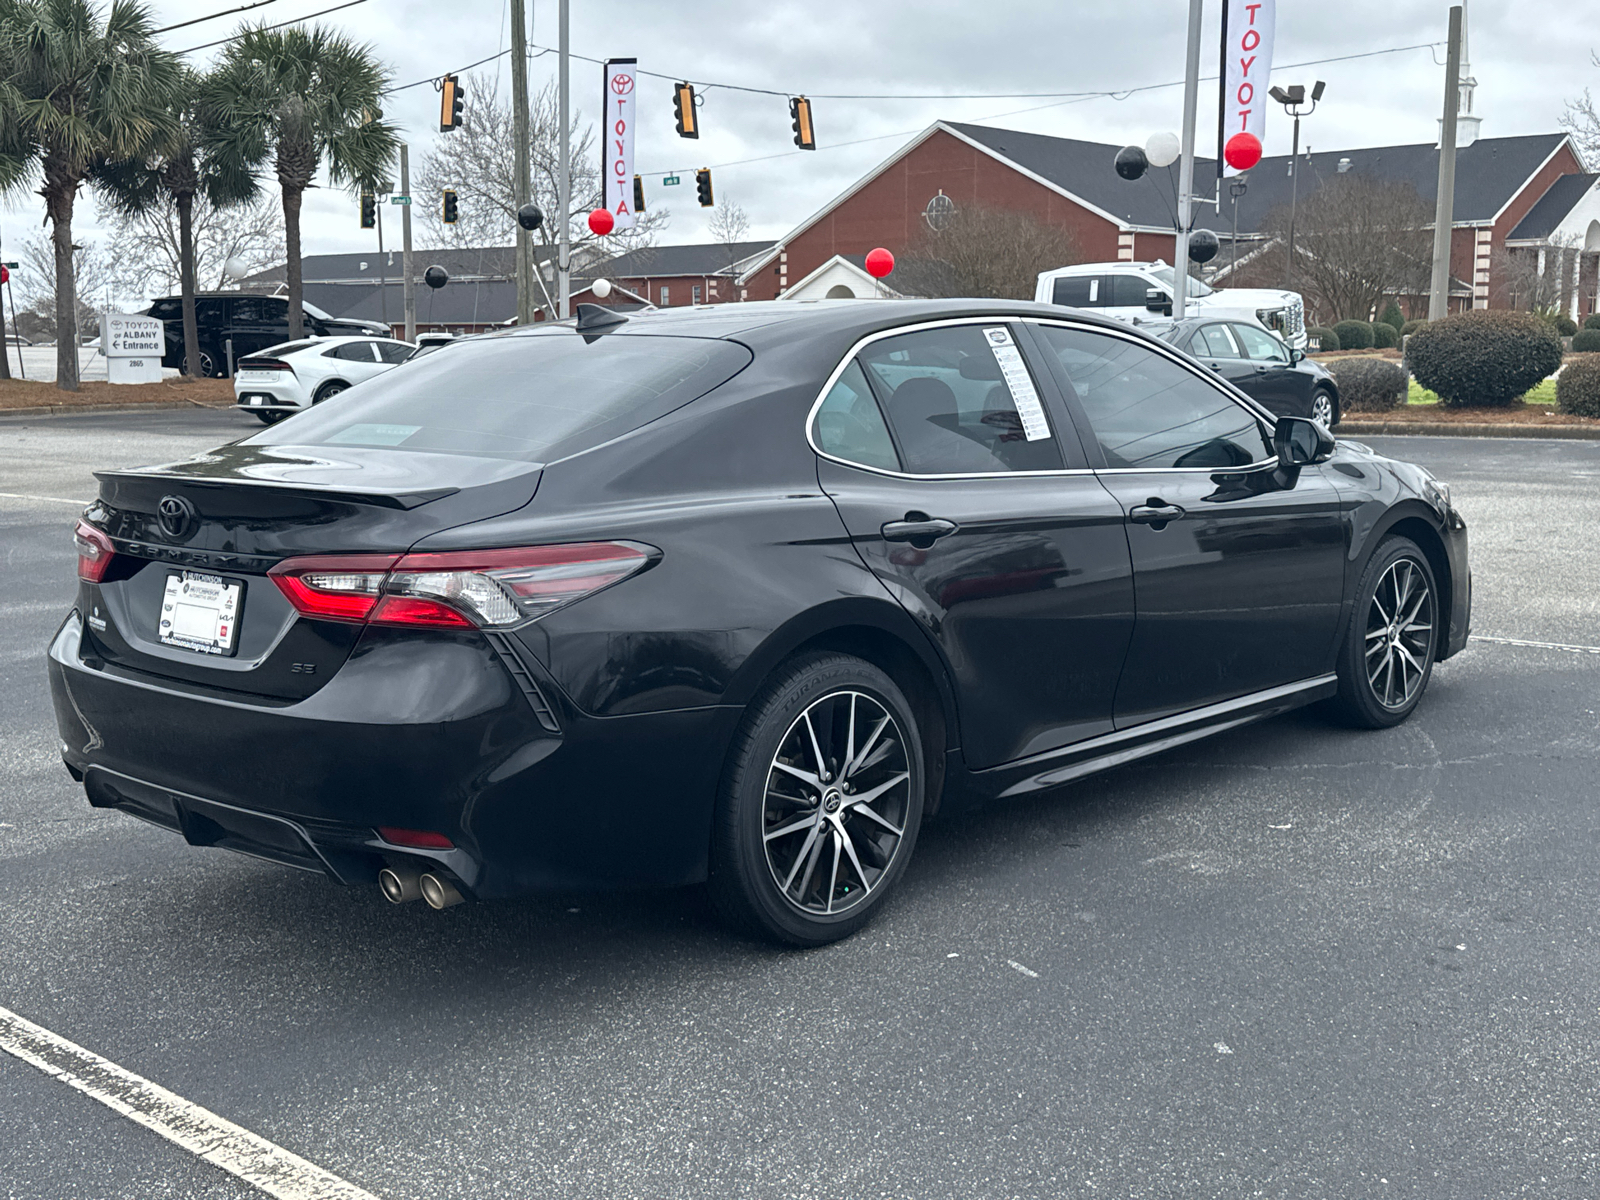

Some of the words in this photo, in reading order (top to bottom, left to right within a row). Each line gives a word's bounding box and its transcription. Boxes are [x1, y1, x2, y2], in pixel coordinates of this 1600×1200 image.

[1237, 4, 1261, 131] TOYOT
[615, 99, 629, 216] TOYOTA
[125, 321, 160, 330] TOYOTA
[123, 331, 157, 339] ALBANY
[123, 340, 159, 350] Entrance
[129, 543, 238, 564] CAMRY
[188, 572, 223, 585] HUTCHINSON
[291, 662, 317, 674] SE
[781, 667, 851, 712] TURANZA
